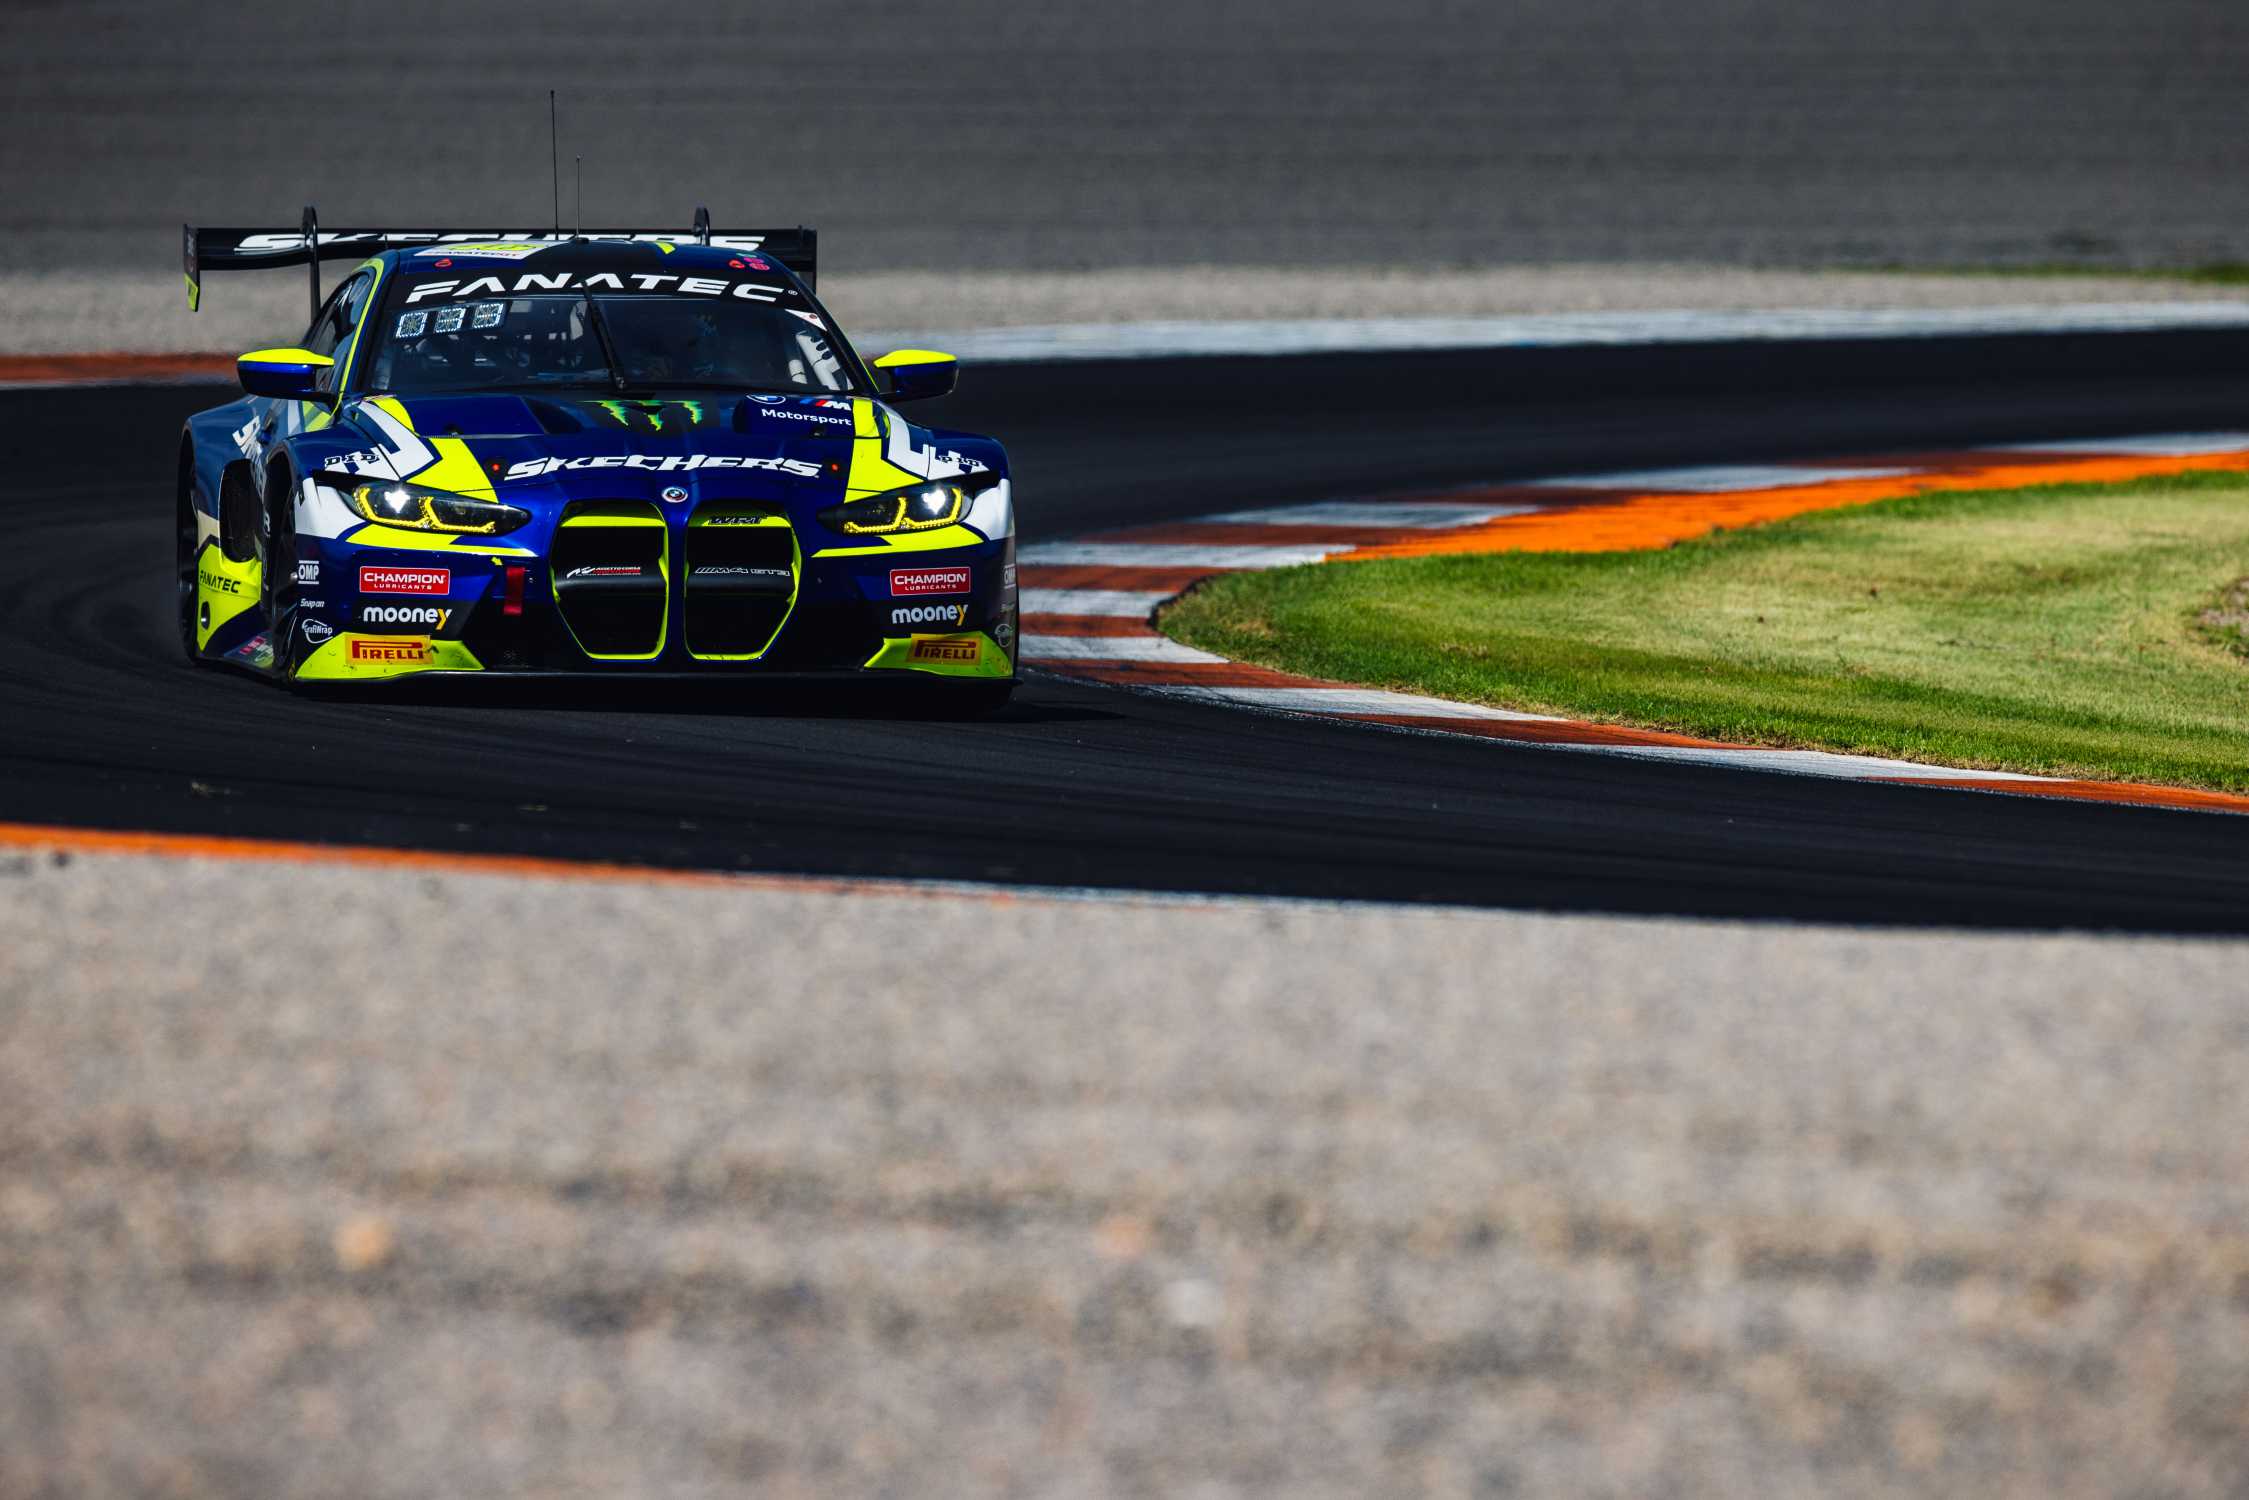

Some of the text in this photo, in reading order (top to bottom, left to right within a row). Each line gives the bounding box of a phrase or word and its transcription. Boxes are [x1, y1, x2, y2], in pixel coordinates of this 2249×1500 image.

[405, 272, 785, 304] FANATEC
[761, 408, 852, 426] Motorsport
[503, 454, 823, 481] SKECHERS
[200, 569, 241, 594] FANATEC
[298, 564, 320, 581] OMP
[363, 572, 446, 585] CHAMPION
[894, 573, 967, 586] CHAMPION
[363, 606, 453, 631] mooney
[891, 603, 969, 627] mooney
[351, 640, 424, 660] PIRELLI
[913, 639, 977, 660] PIRELLI
